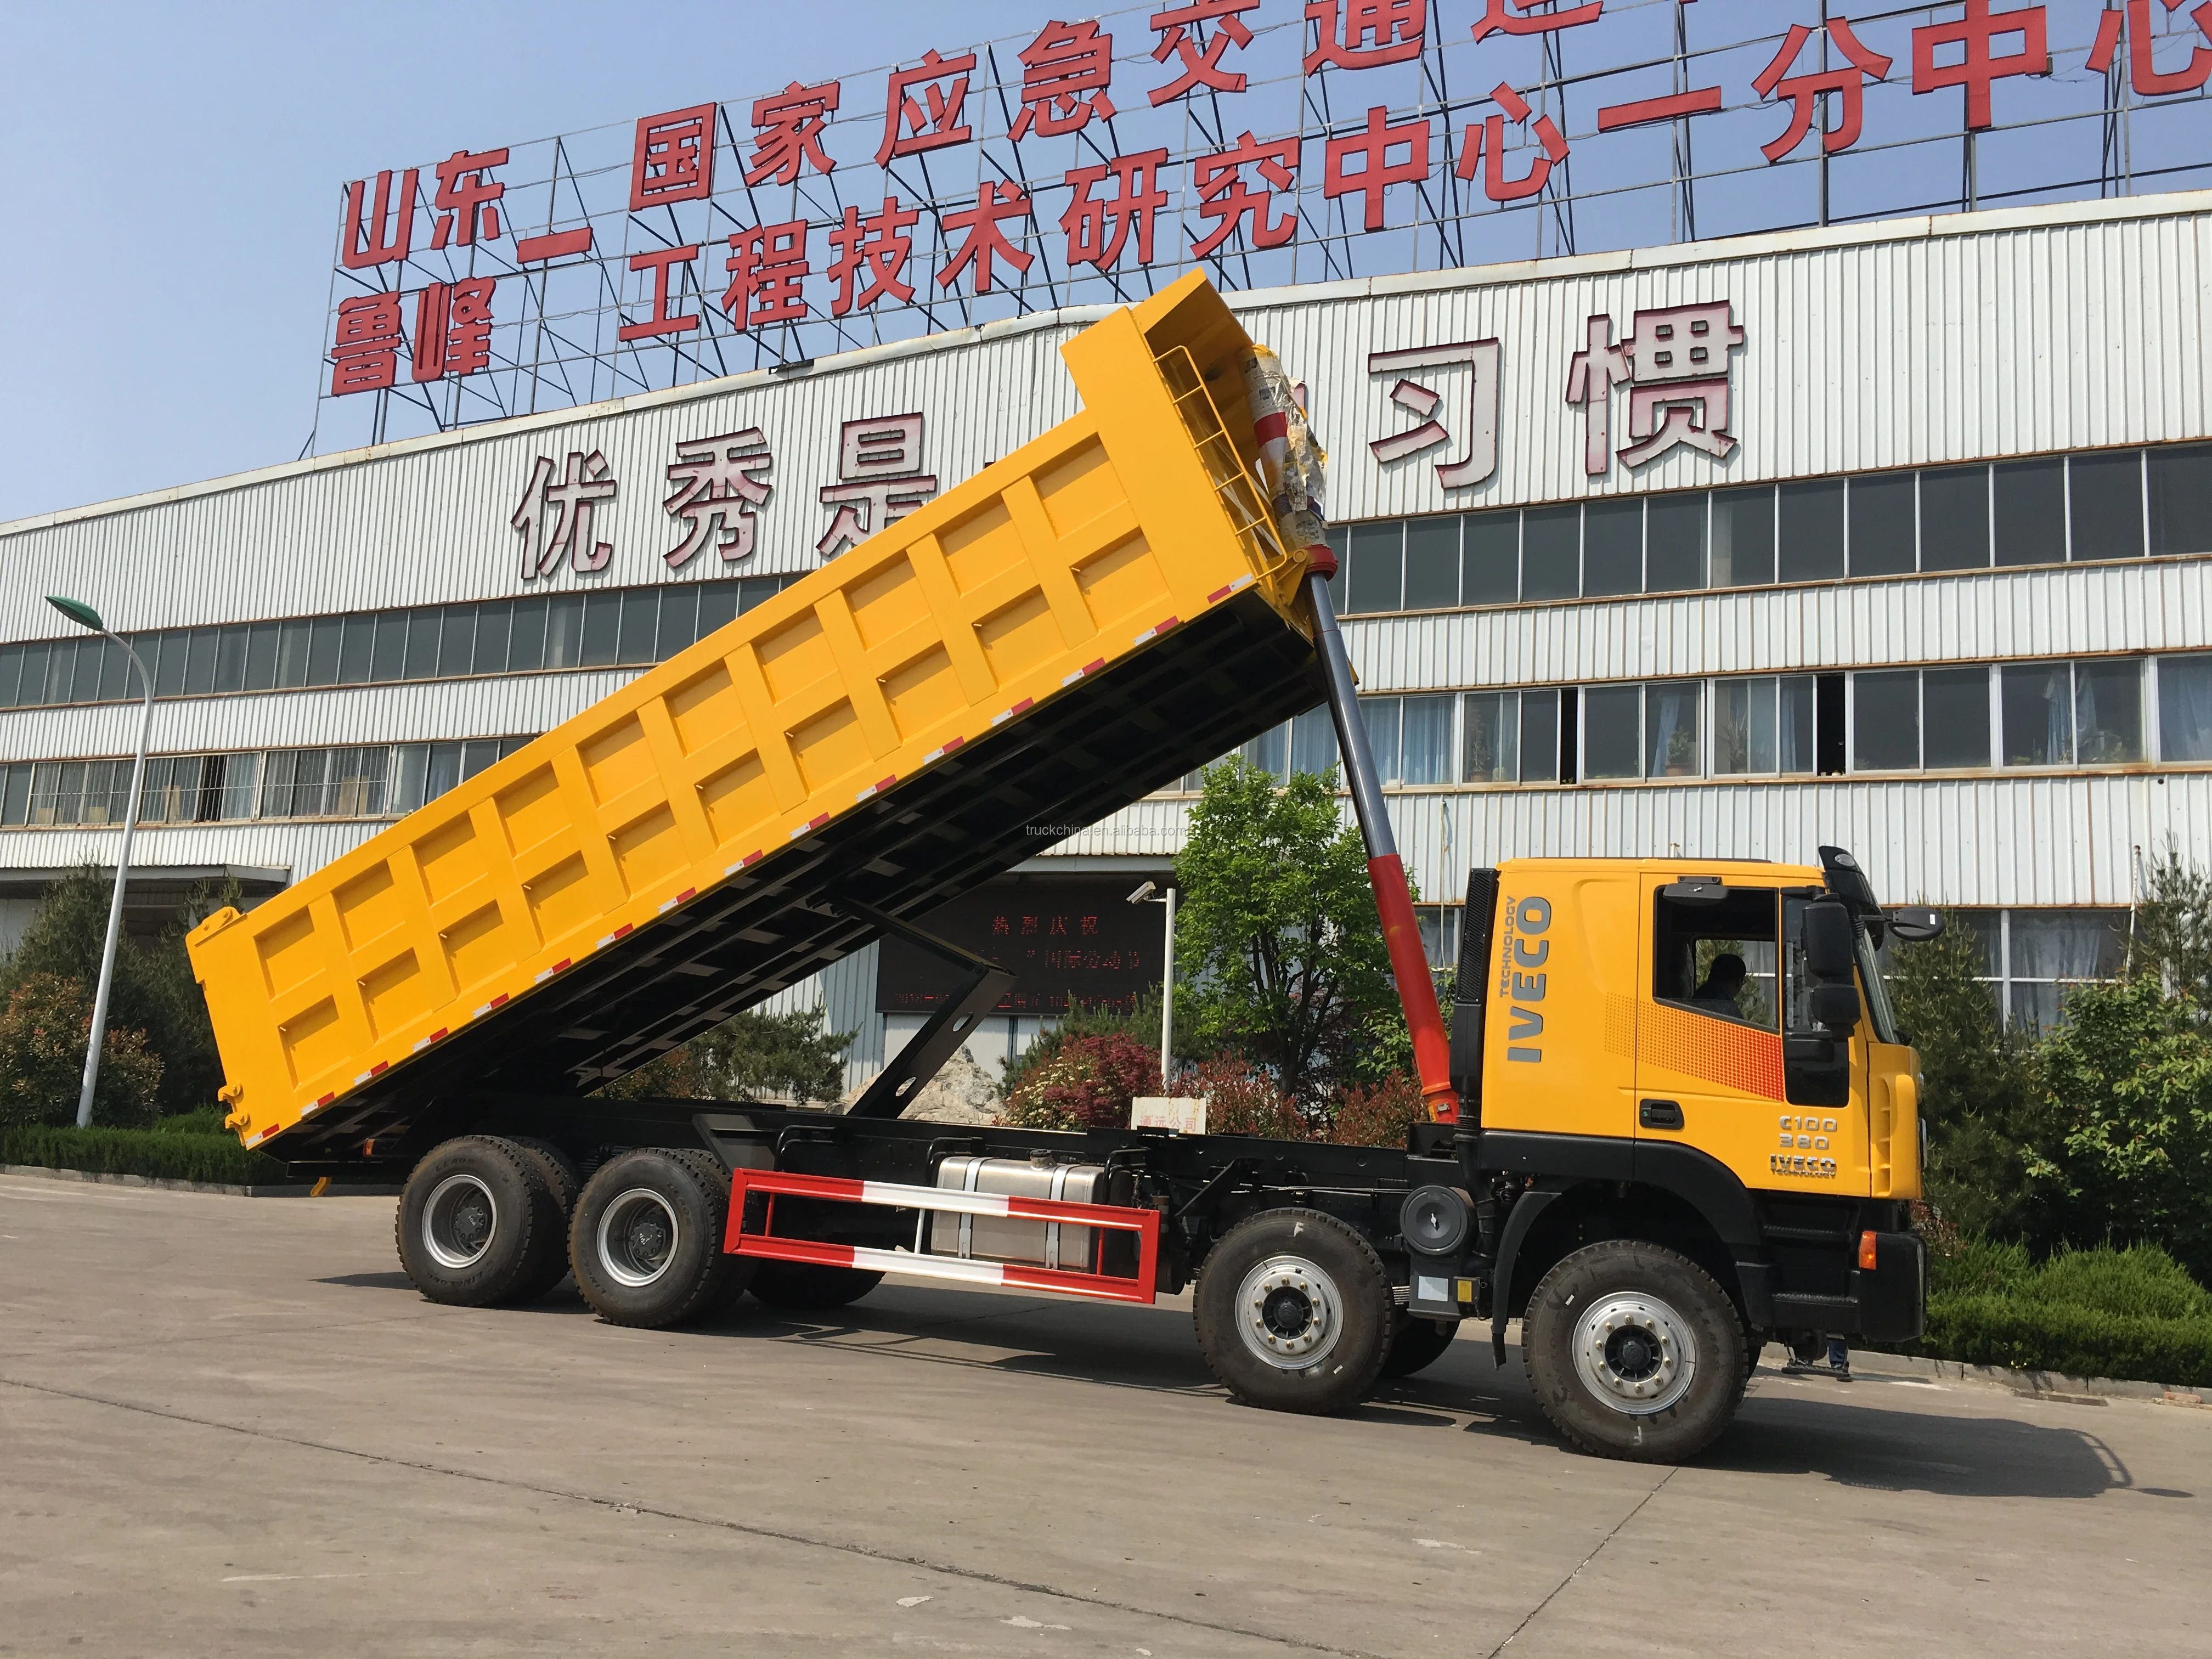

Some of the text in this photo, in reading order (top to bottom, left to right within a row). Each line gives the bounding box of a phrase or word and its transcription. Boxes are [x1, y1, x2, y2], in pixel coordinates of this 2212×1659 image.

[342, 148, 509, 270] 山东
[331, 276, 496, 397] 鲁峰
[511, 411, 938, 579] 优秀是
[1499, 896, 1515, 997] TECHNOLOGY
[1507, 896, 1551, 1063] IVECO
[1770, 1154, 1837, 1172] IVECO
[1779, 1133, 1829, 1150] 380
[1780, 1116, 1837, 1132] C100
